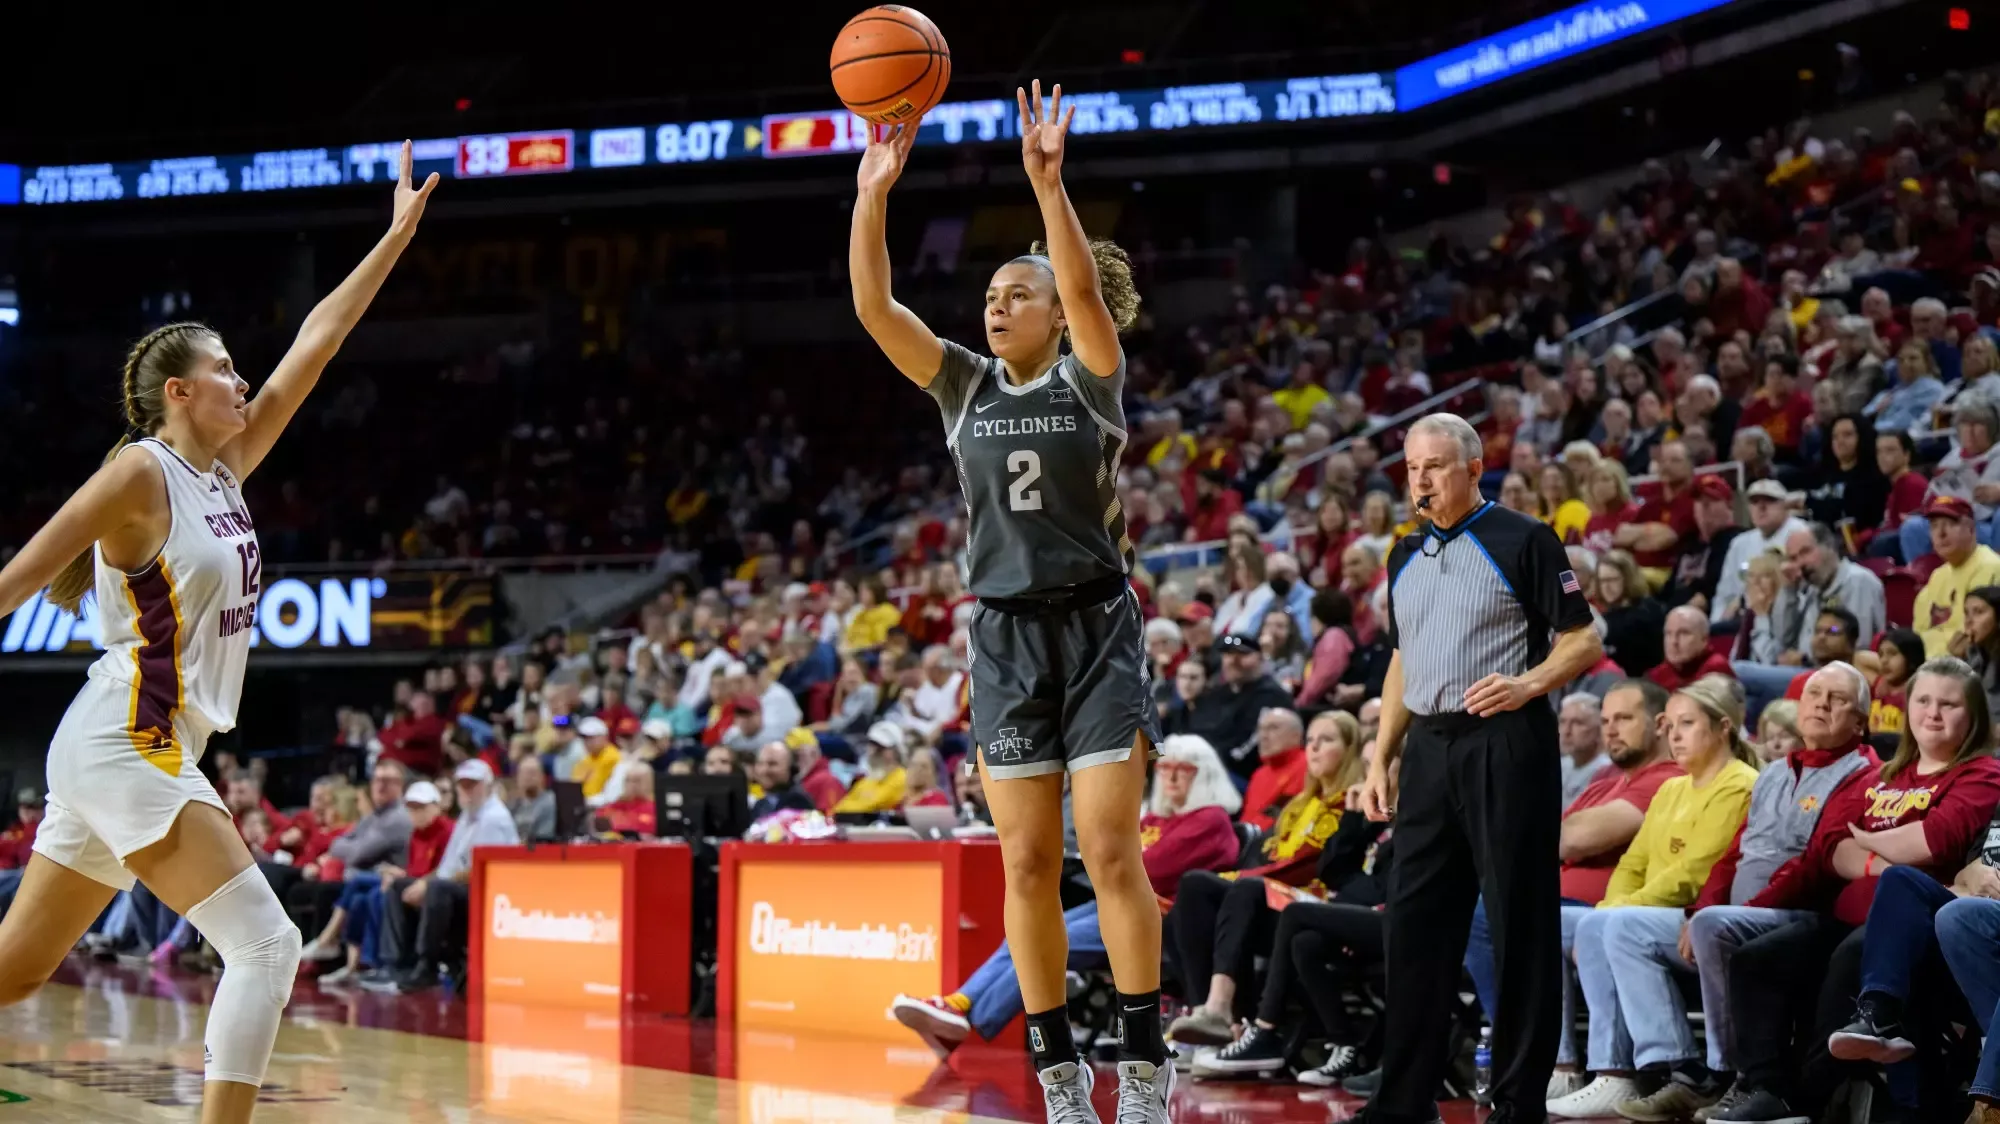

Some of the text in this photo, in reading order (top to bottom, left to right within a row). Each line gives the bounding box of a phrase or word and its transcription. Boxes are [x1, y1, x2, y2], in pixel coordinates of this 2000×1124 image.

[466, 137, 509, 175] 33
[656, 120, 733, 163] 8:07
[973, 416, 1077, 437] CYCLONES
[1007, 450, 1043, 511] 2
[236, 540, 261, 597] 12
[989, 737, 1033, 755] STATE
